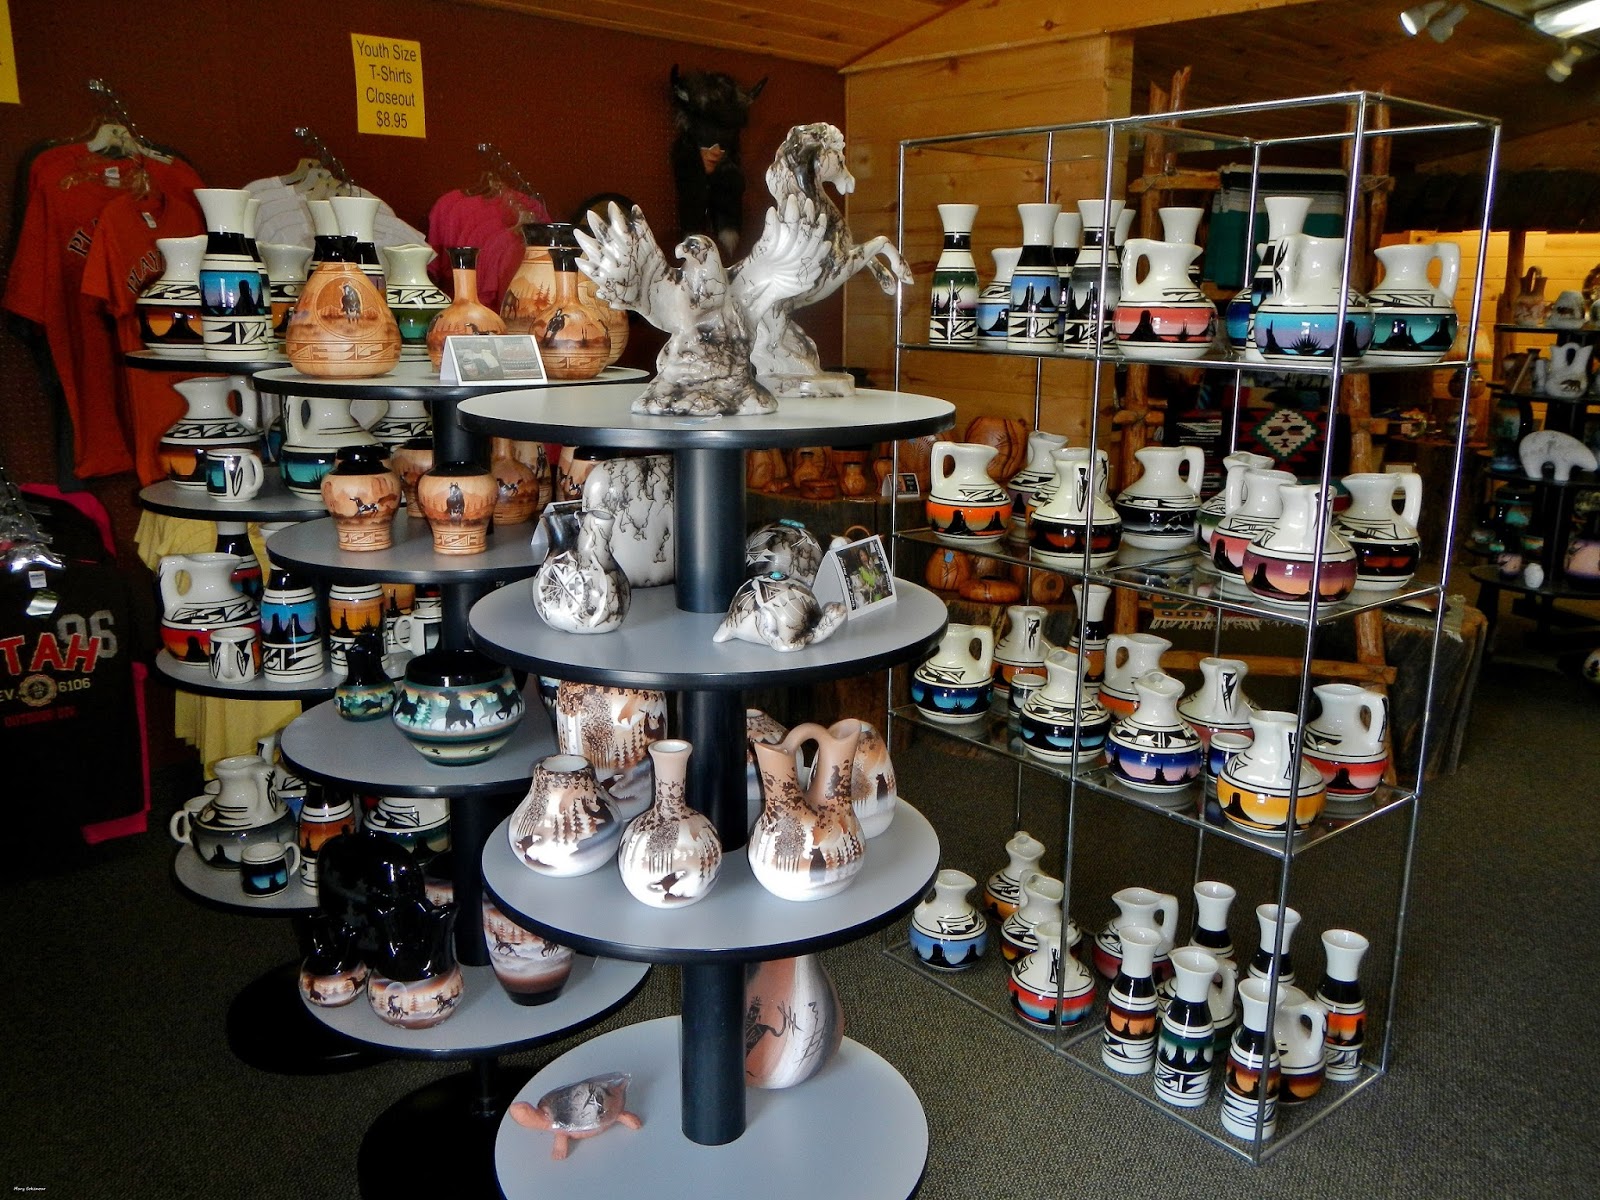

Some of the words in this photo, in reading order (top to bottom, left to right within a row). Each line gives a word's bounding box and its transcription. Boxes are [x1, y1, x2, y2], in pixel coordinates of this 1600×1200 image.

[356, 39, 390, 59] Youth
[392, 44, 417, 62] Size
[369, 64, 412, 84] T-Shirts
[366, 86, 415, 107] Closeout
[376, 110, 408, 128] $8.95
[56, 610, 118, 659] 96
[58, 677, 91, 693] 6106
